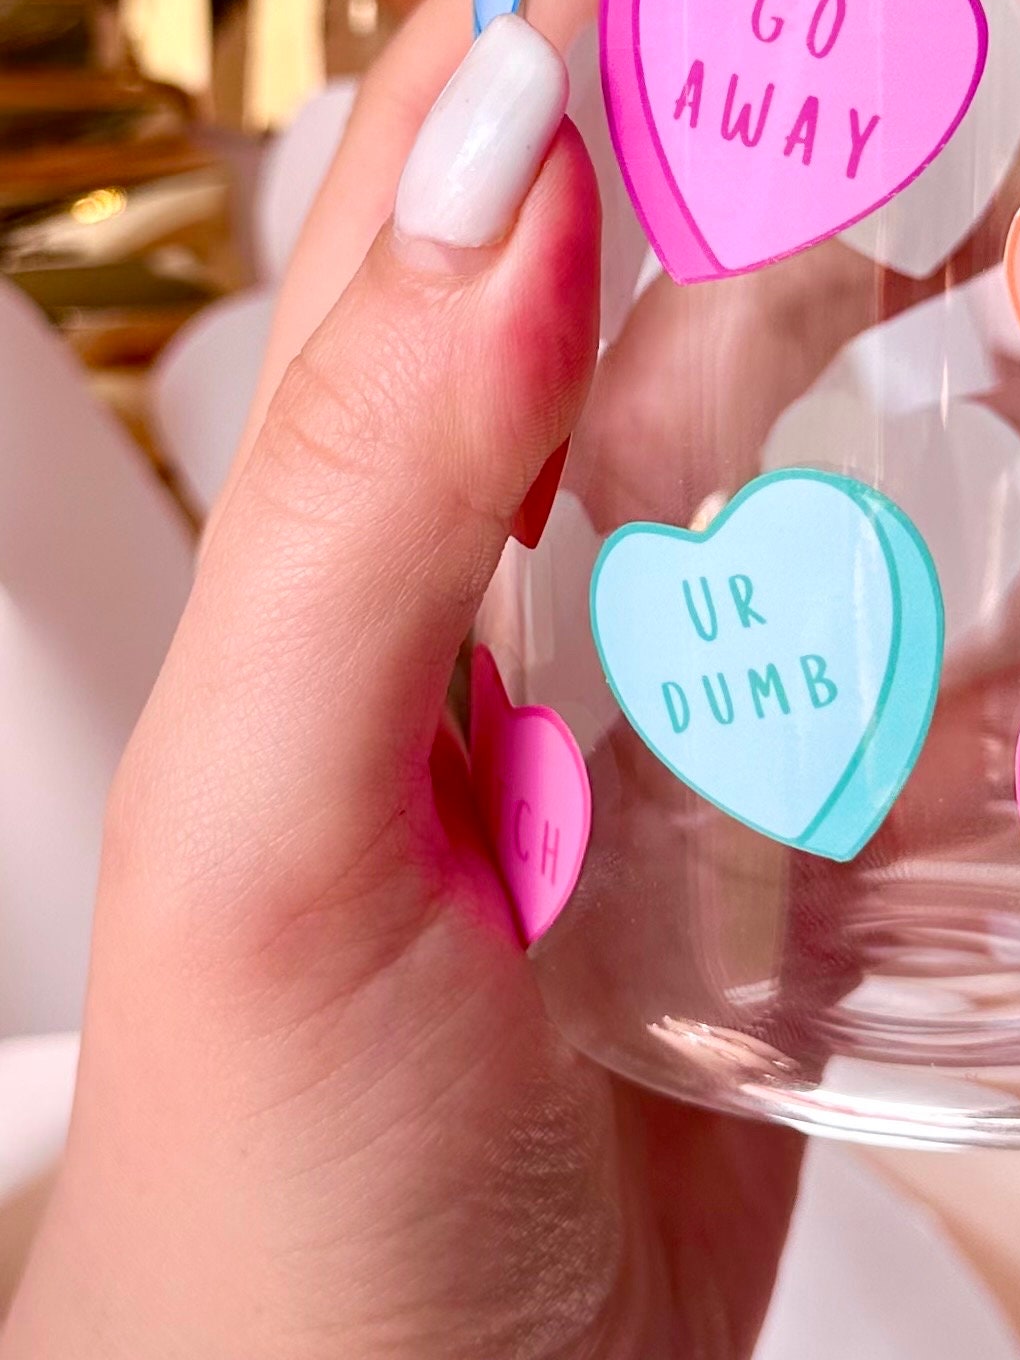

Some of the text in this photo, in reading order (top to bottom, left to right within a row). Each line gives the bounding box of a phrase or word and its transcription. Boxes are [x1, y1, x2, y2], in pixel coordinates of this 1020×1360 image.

[672, 58, 881, 180] AWAY
[681, 573, 768, 642] UR
[661, 653, 839, 735] DUMB
